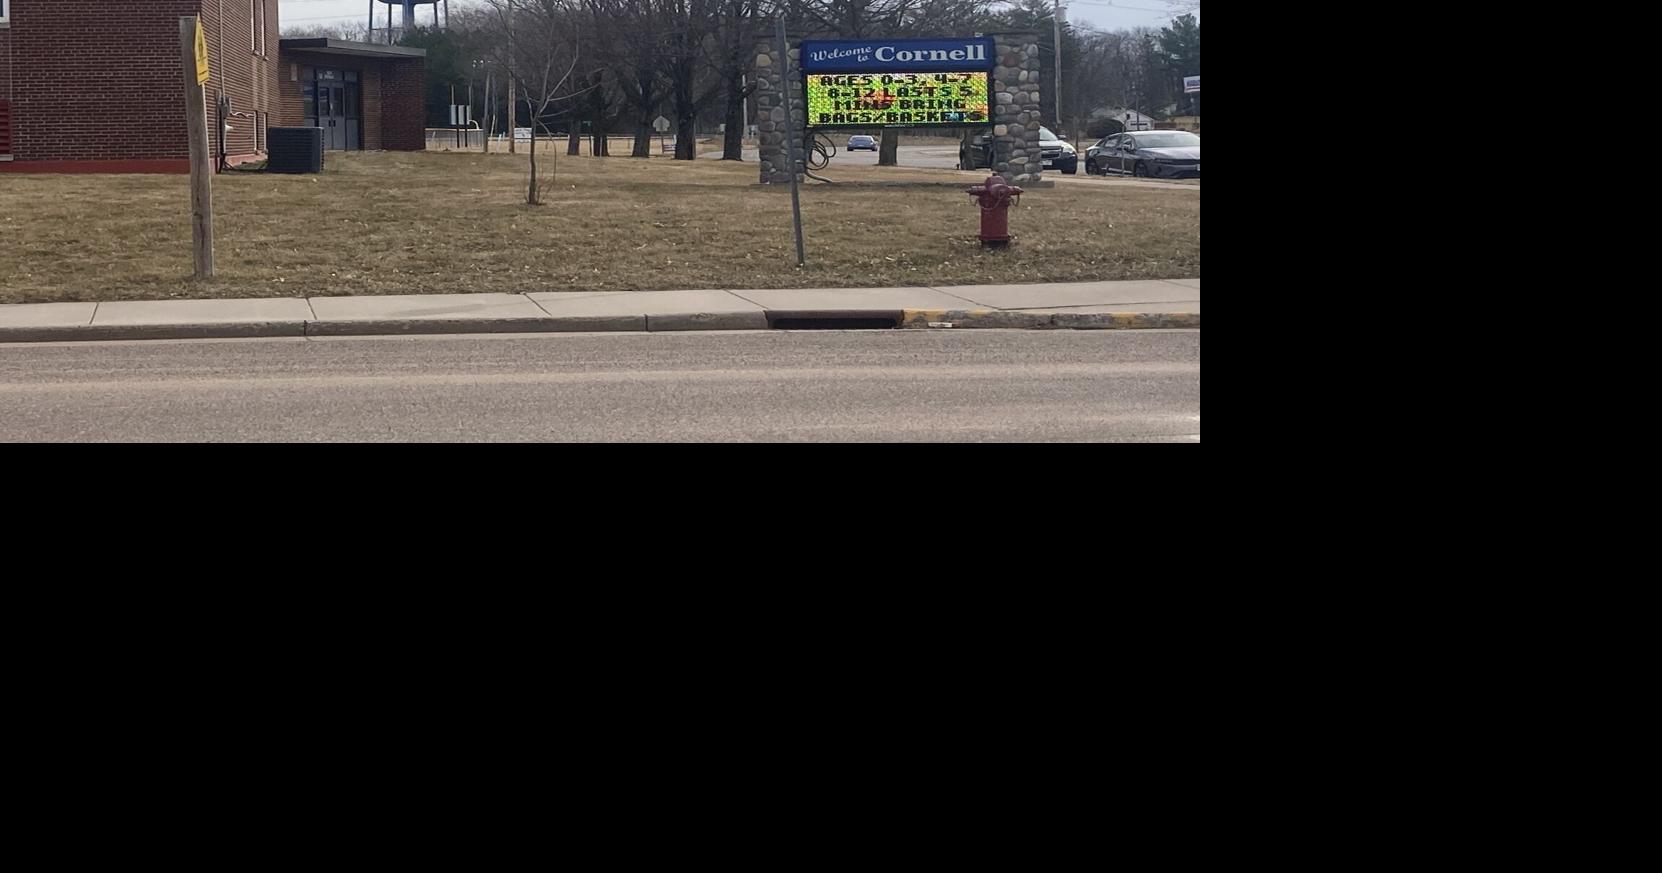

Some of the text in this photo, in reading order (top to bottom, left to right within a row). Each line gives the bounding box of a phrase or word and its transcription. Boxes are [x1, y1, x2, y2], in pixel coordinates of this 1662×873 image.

[810, 45, 873, 62] Welcome
[857, 54, 870, 63] to
[875, 44, 986, 62] Cornell
[820, 75, 873, 86] AGES
[898, 98, 967, 110] BRING
